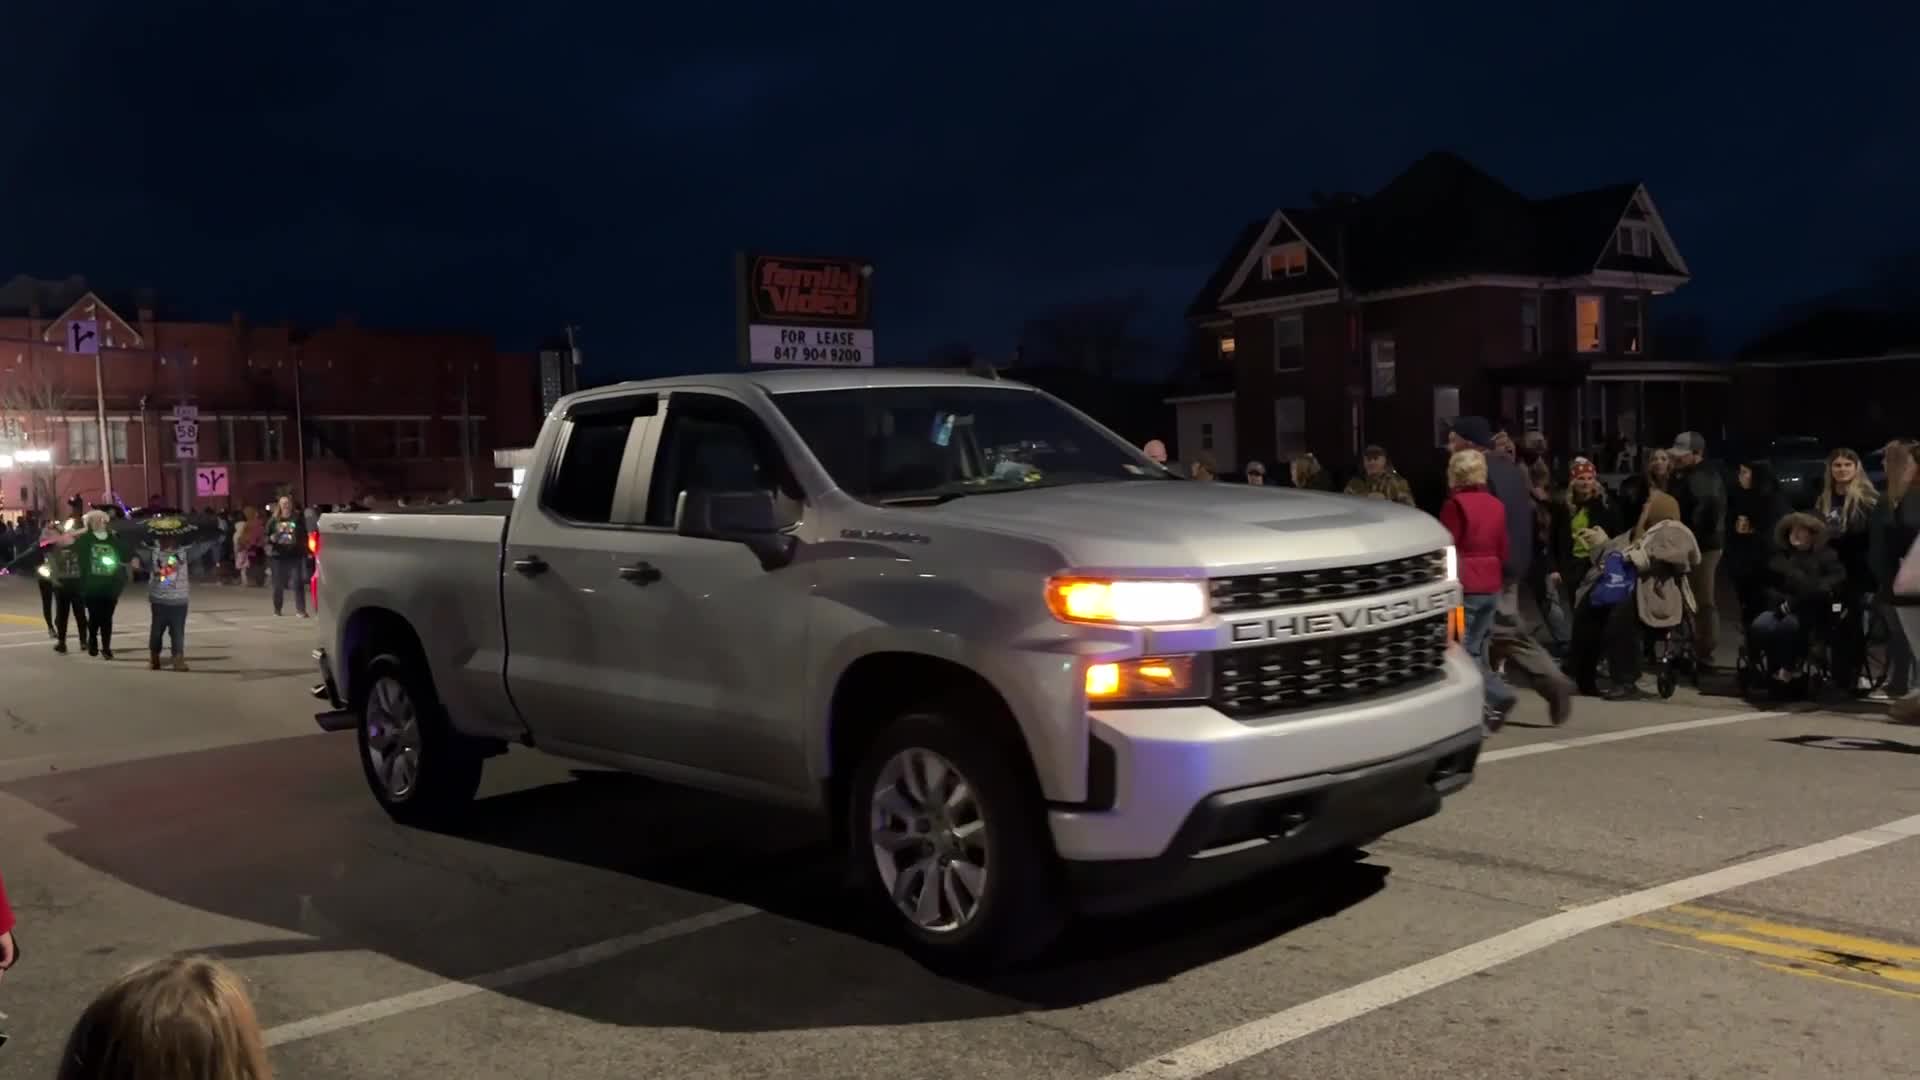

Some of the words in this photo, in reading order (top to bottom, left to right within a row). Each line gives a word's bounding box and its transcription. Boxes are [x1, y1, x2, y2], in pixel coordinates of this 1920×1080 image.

[763, 286, 857, 314] Video
[781, 329, 806, 344] FOR
[817, 331, 855, 346] LEASE
[774, 346, 797, 360] 847
[803, 347, 826, 361] 904
[831, 349, 861, 362] 9200
[177, 425, 196, 438] 58
[1231, 588, 1457, 644] CHEVROLET
